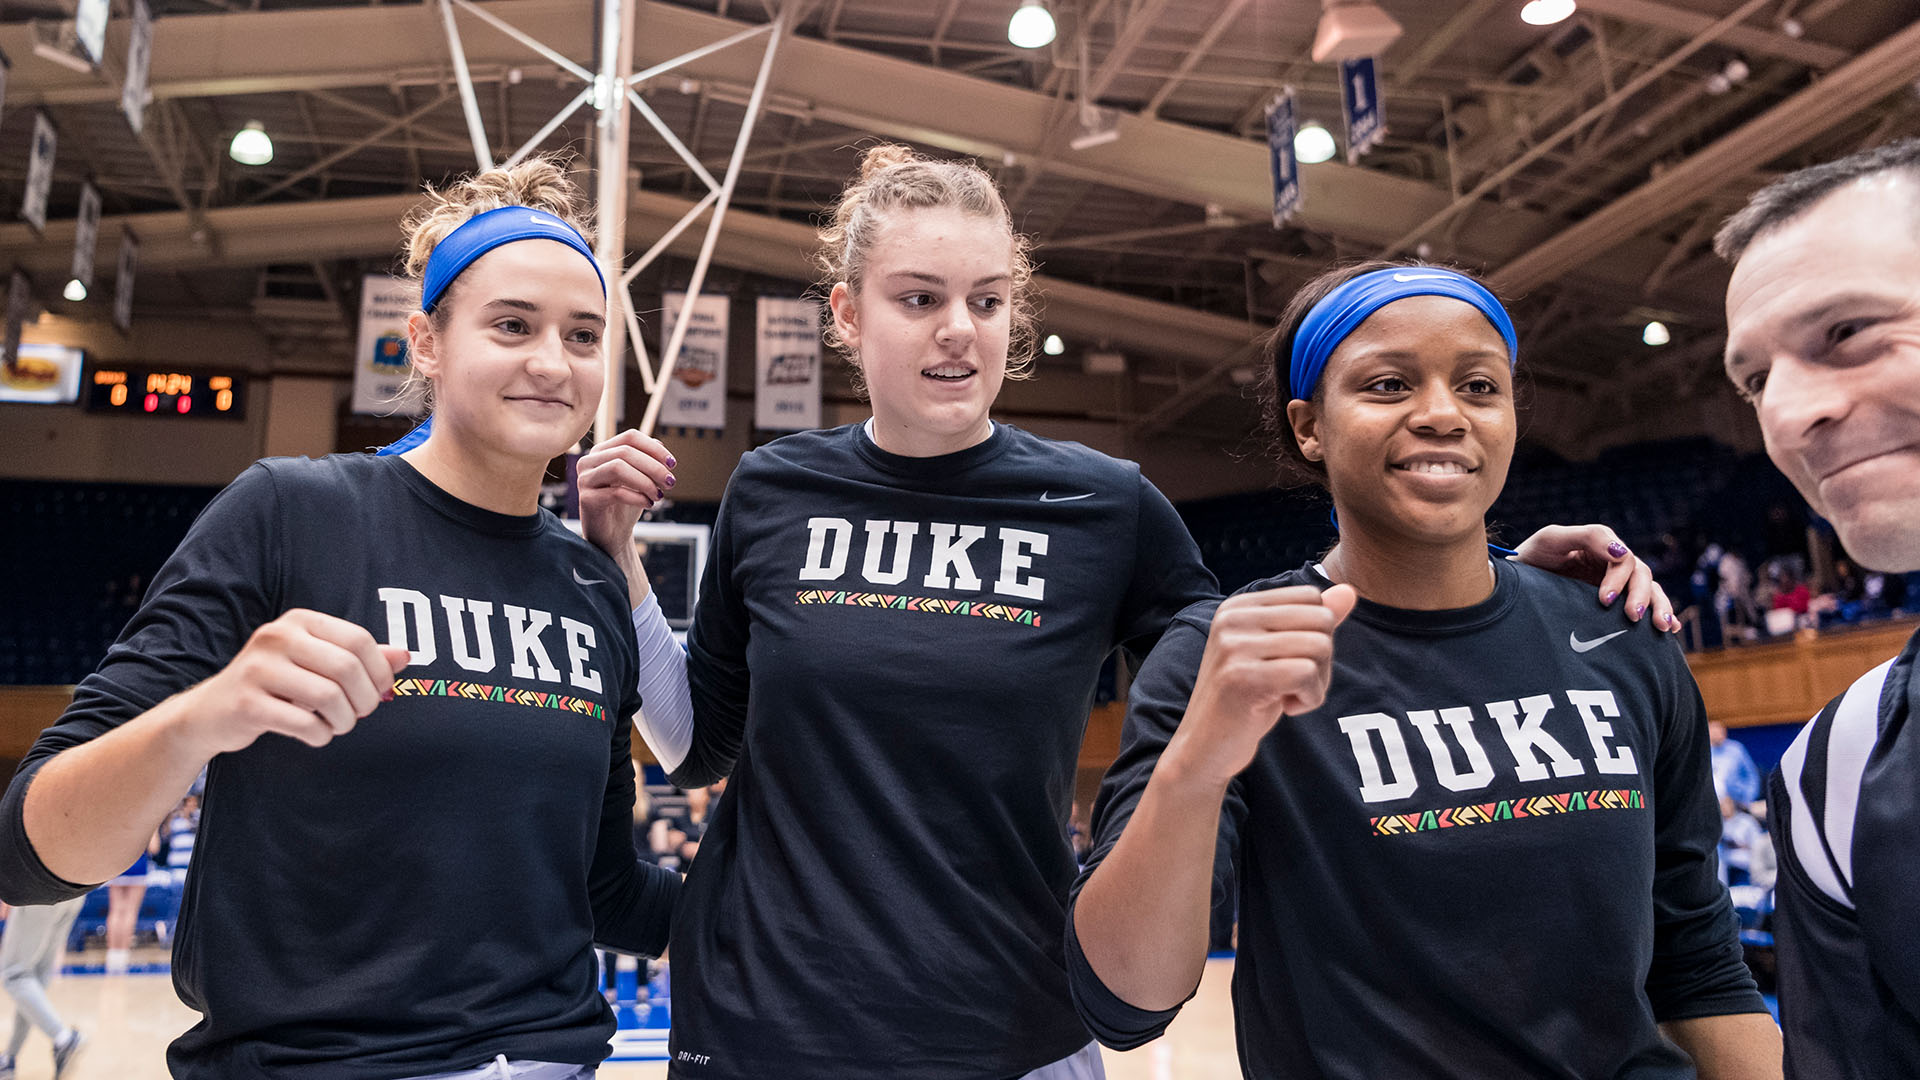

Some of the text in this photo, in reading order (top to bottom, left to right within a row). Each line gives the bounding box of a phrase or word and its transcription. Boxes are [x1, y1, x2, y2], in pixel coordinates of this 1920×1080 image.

[799, 517, 1049, 600] DUKE
[378, 587, 603, 694] DUKE
[1337, 690, 1639, 803] DUKE
[678, 1051, 710, 1065] DRI-FIT
